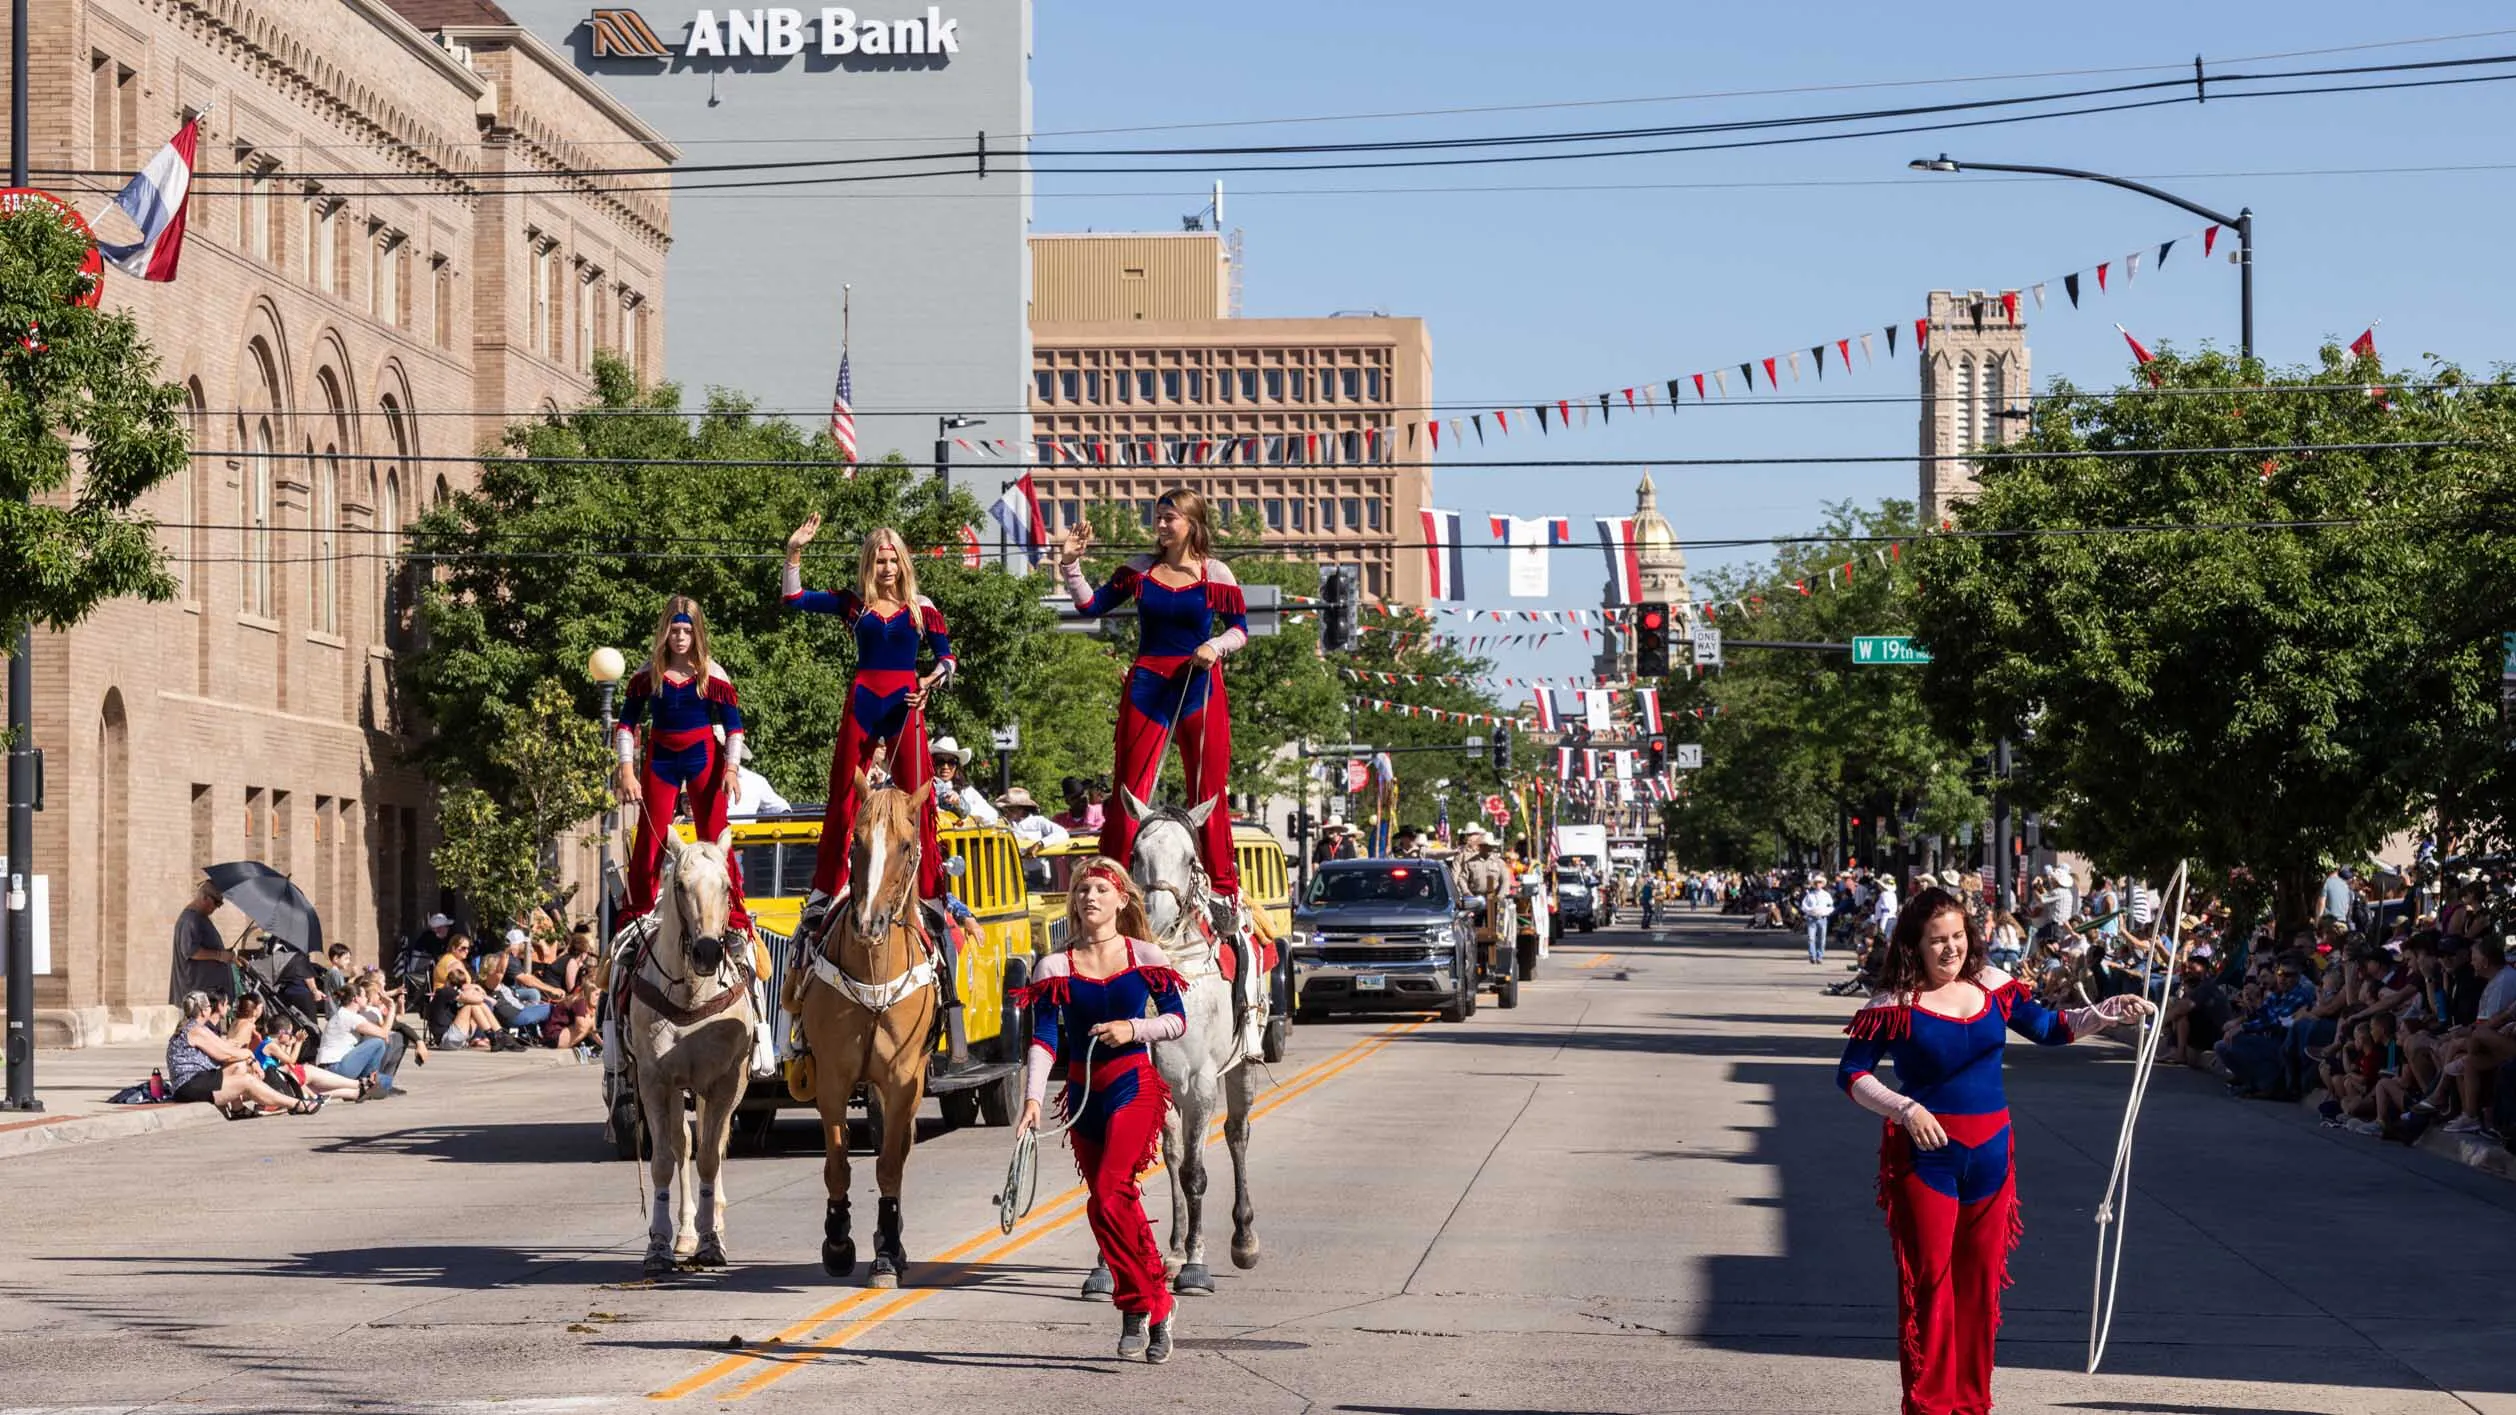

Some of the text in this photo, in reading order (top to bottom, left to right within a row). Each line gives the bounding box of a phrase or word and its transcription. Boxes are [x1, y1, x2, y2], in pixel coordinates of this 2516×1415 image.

[685, 7, 960, 56] ANB Bank
[1697, 632, 1717, 641] ONE
[1697, 641, 1717, 650] WAY
[1858, 640, 1873, 660] W
